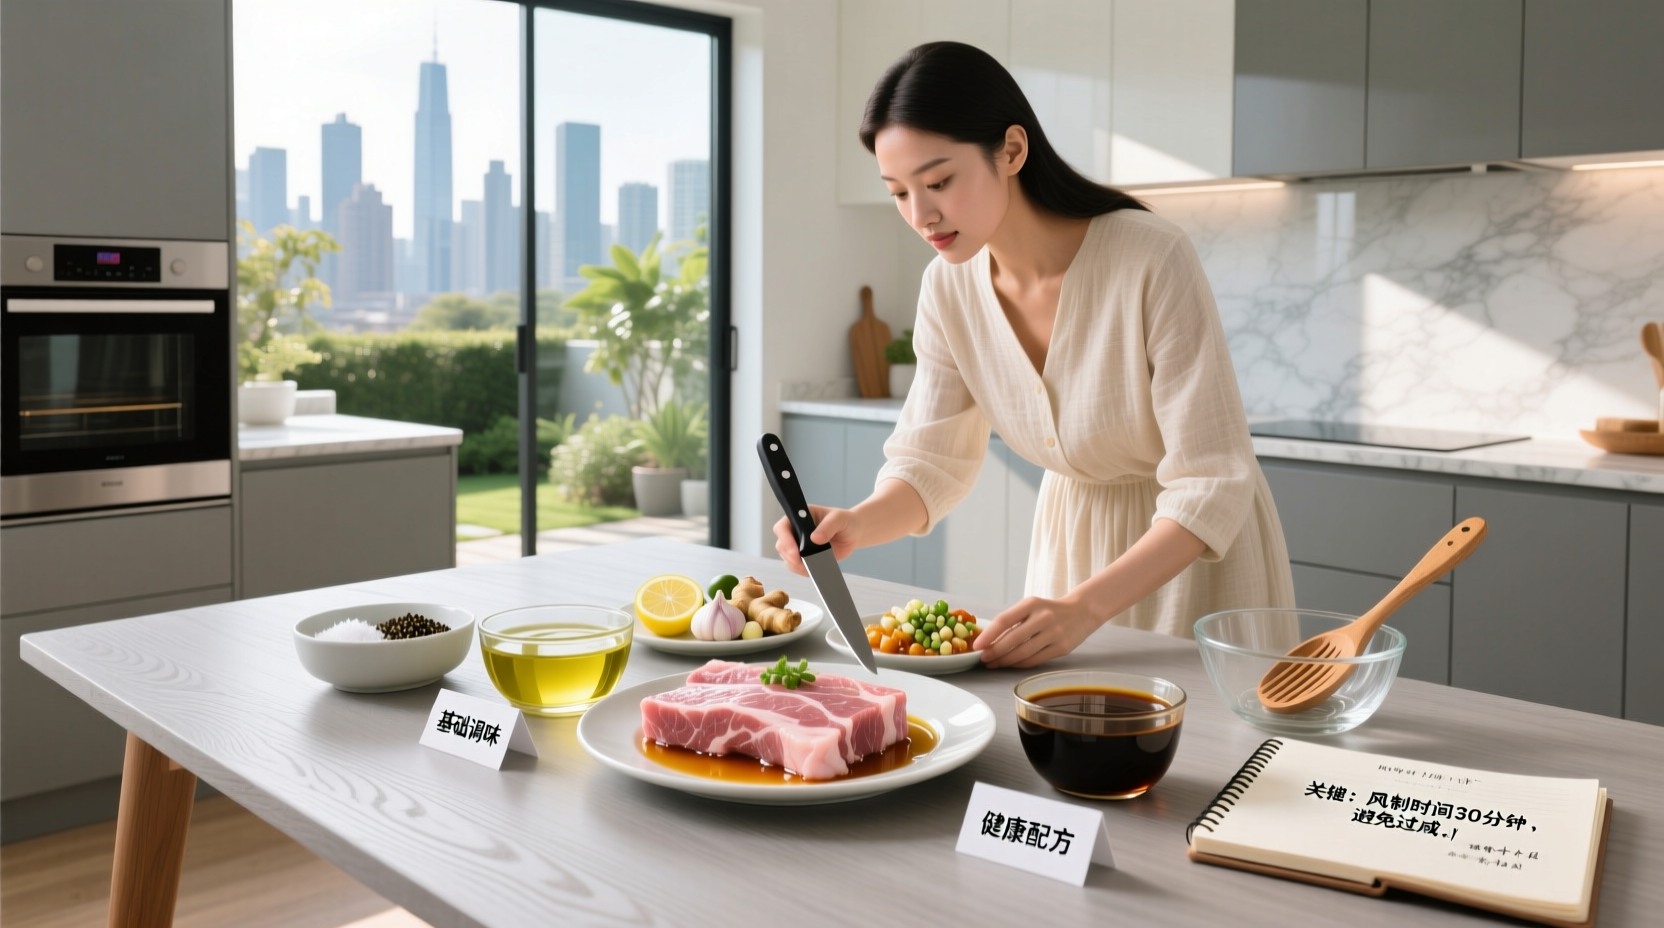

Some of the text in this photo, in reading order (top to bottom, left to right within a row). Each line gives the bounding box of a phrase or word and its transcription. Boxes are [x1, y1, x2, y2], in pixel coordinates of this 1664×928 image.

[436, 709, 502, 747] 基础调味
[981, 810, 1075, 855] 健康配方
